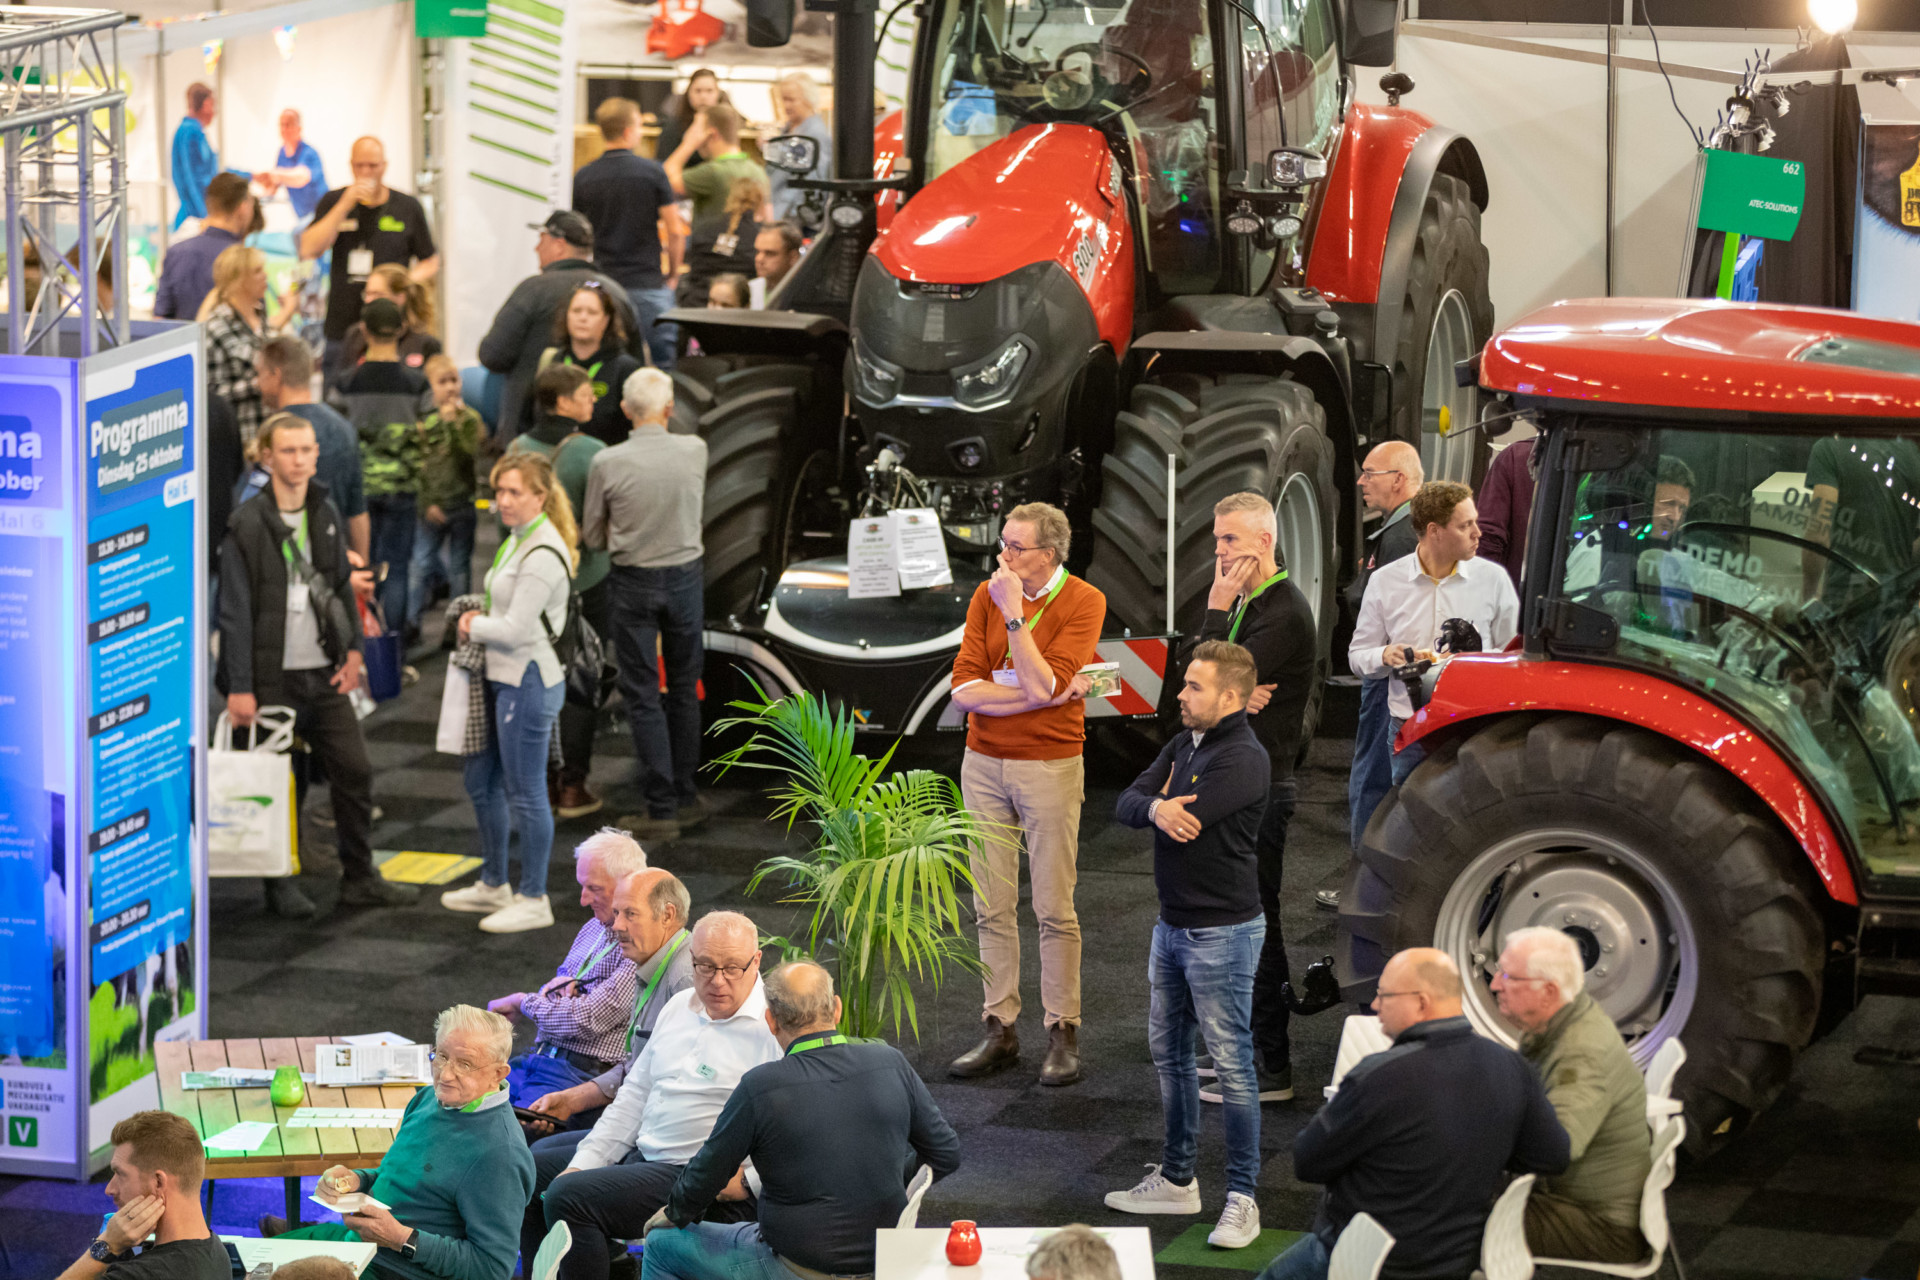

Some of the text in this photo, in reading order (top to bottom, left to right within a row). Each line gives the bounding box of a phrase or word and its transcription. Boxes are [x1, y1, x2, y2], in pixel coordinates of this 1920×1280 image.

[1782, 162, 1800, 175] 662
[1748, 200, 1798, 214] ATEC-SOLUTIONS
[1073, 233, 1094, 277] 300
[920, 284, 950, 292] CASE
[91, 401, 188, 458] Programma
[98, 444, 184, 488] Dinsdag 25 oktober
[168, 480, 189, 499] Hal 6
[1687, 544, 1763, 578] DEMO
[8, 1080, 44, 1090] RUNDVEE
[8, 1092, 65, 1103] MECHANISATIE
[8, 1102, 50, 1112] VAKDAGEN
[15, 1122, 31, 1142] V
